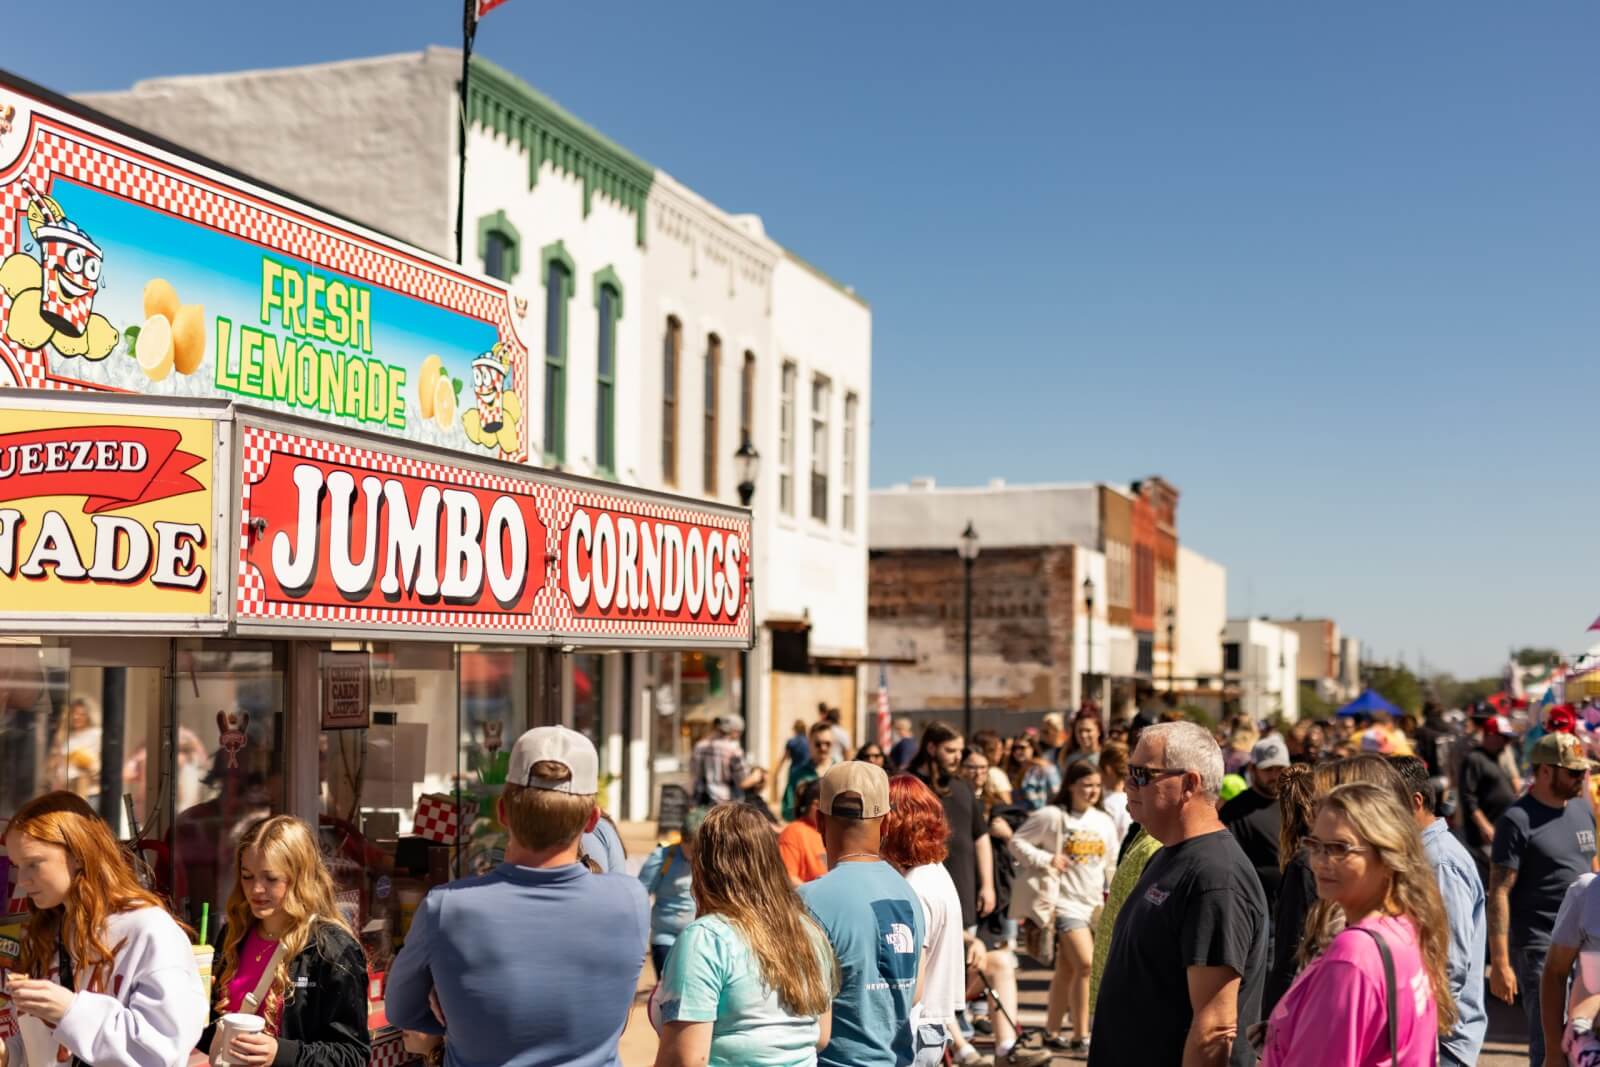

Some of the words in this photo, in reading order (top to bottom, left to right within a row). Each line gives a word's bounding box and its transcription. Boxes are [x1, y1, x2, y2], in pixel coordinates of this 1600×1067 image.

[260, 255, 373, 354] FRESH
[214, 315, 406, 430] LEMONADE
[272, 463, 529, 607] JUMBO
[567, 509, 742, 619] CORNDOGS
[332, 683, 360, 700] CARDS
